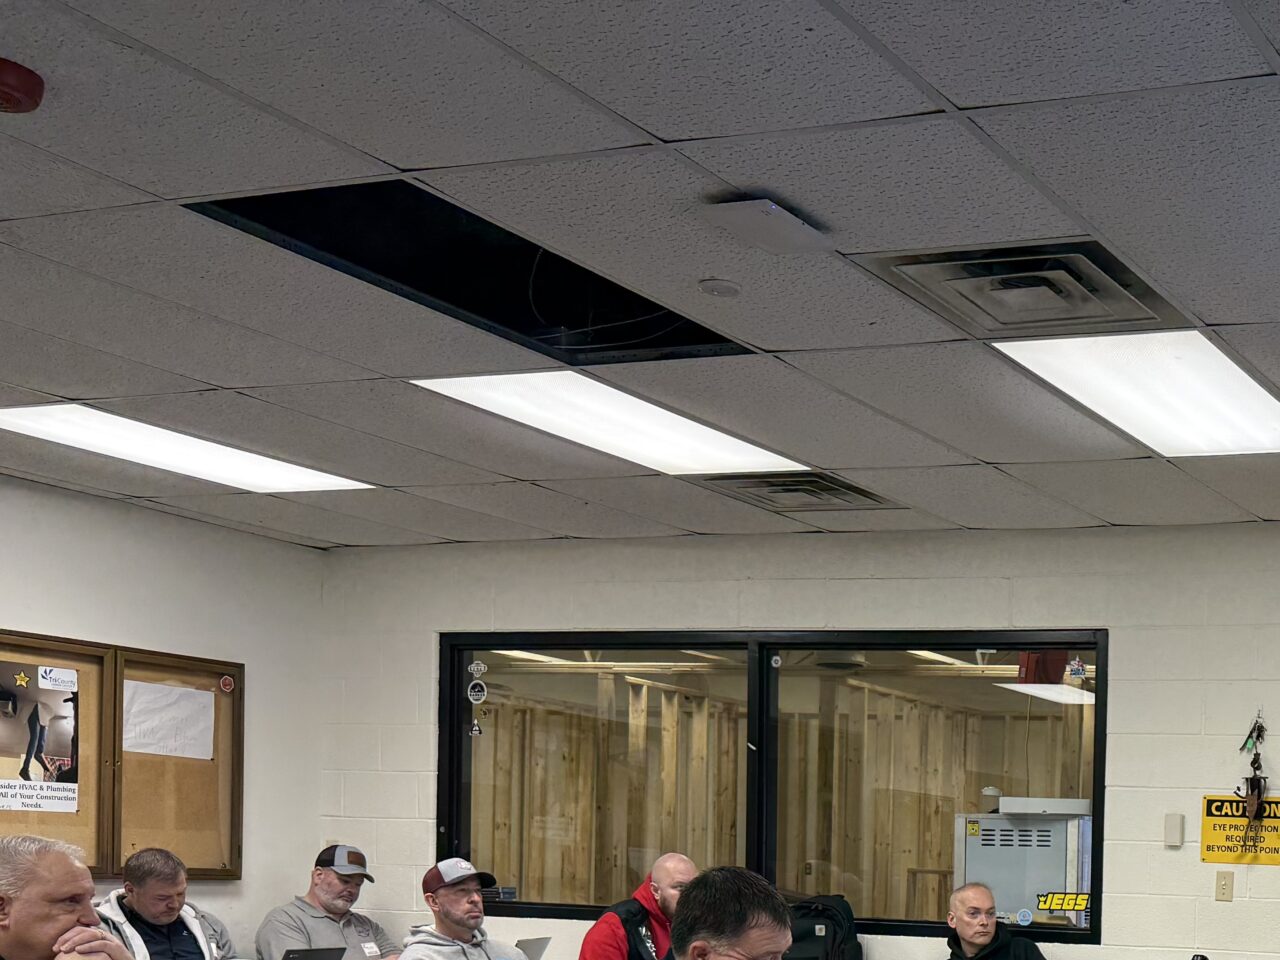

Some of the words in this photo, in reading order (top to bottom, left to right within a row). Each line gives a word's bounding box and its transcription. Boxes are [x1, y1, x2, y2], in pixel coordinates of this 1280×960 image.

[46, 785, 76, 794] Plumbing
[36, 793, 76, 801] Construction
[1213, 823, 1227, 831] EYE
[1225, 835, 1265, 843] REQUIRED
[1206, 845, 1238, 853] BEYOND
[1240, 845, 1258, 853] THIS
[1038, 893, 1090, 910] JEGS
